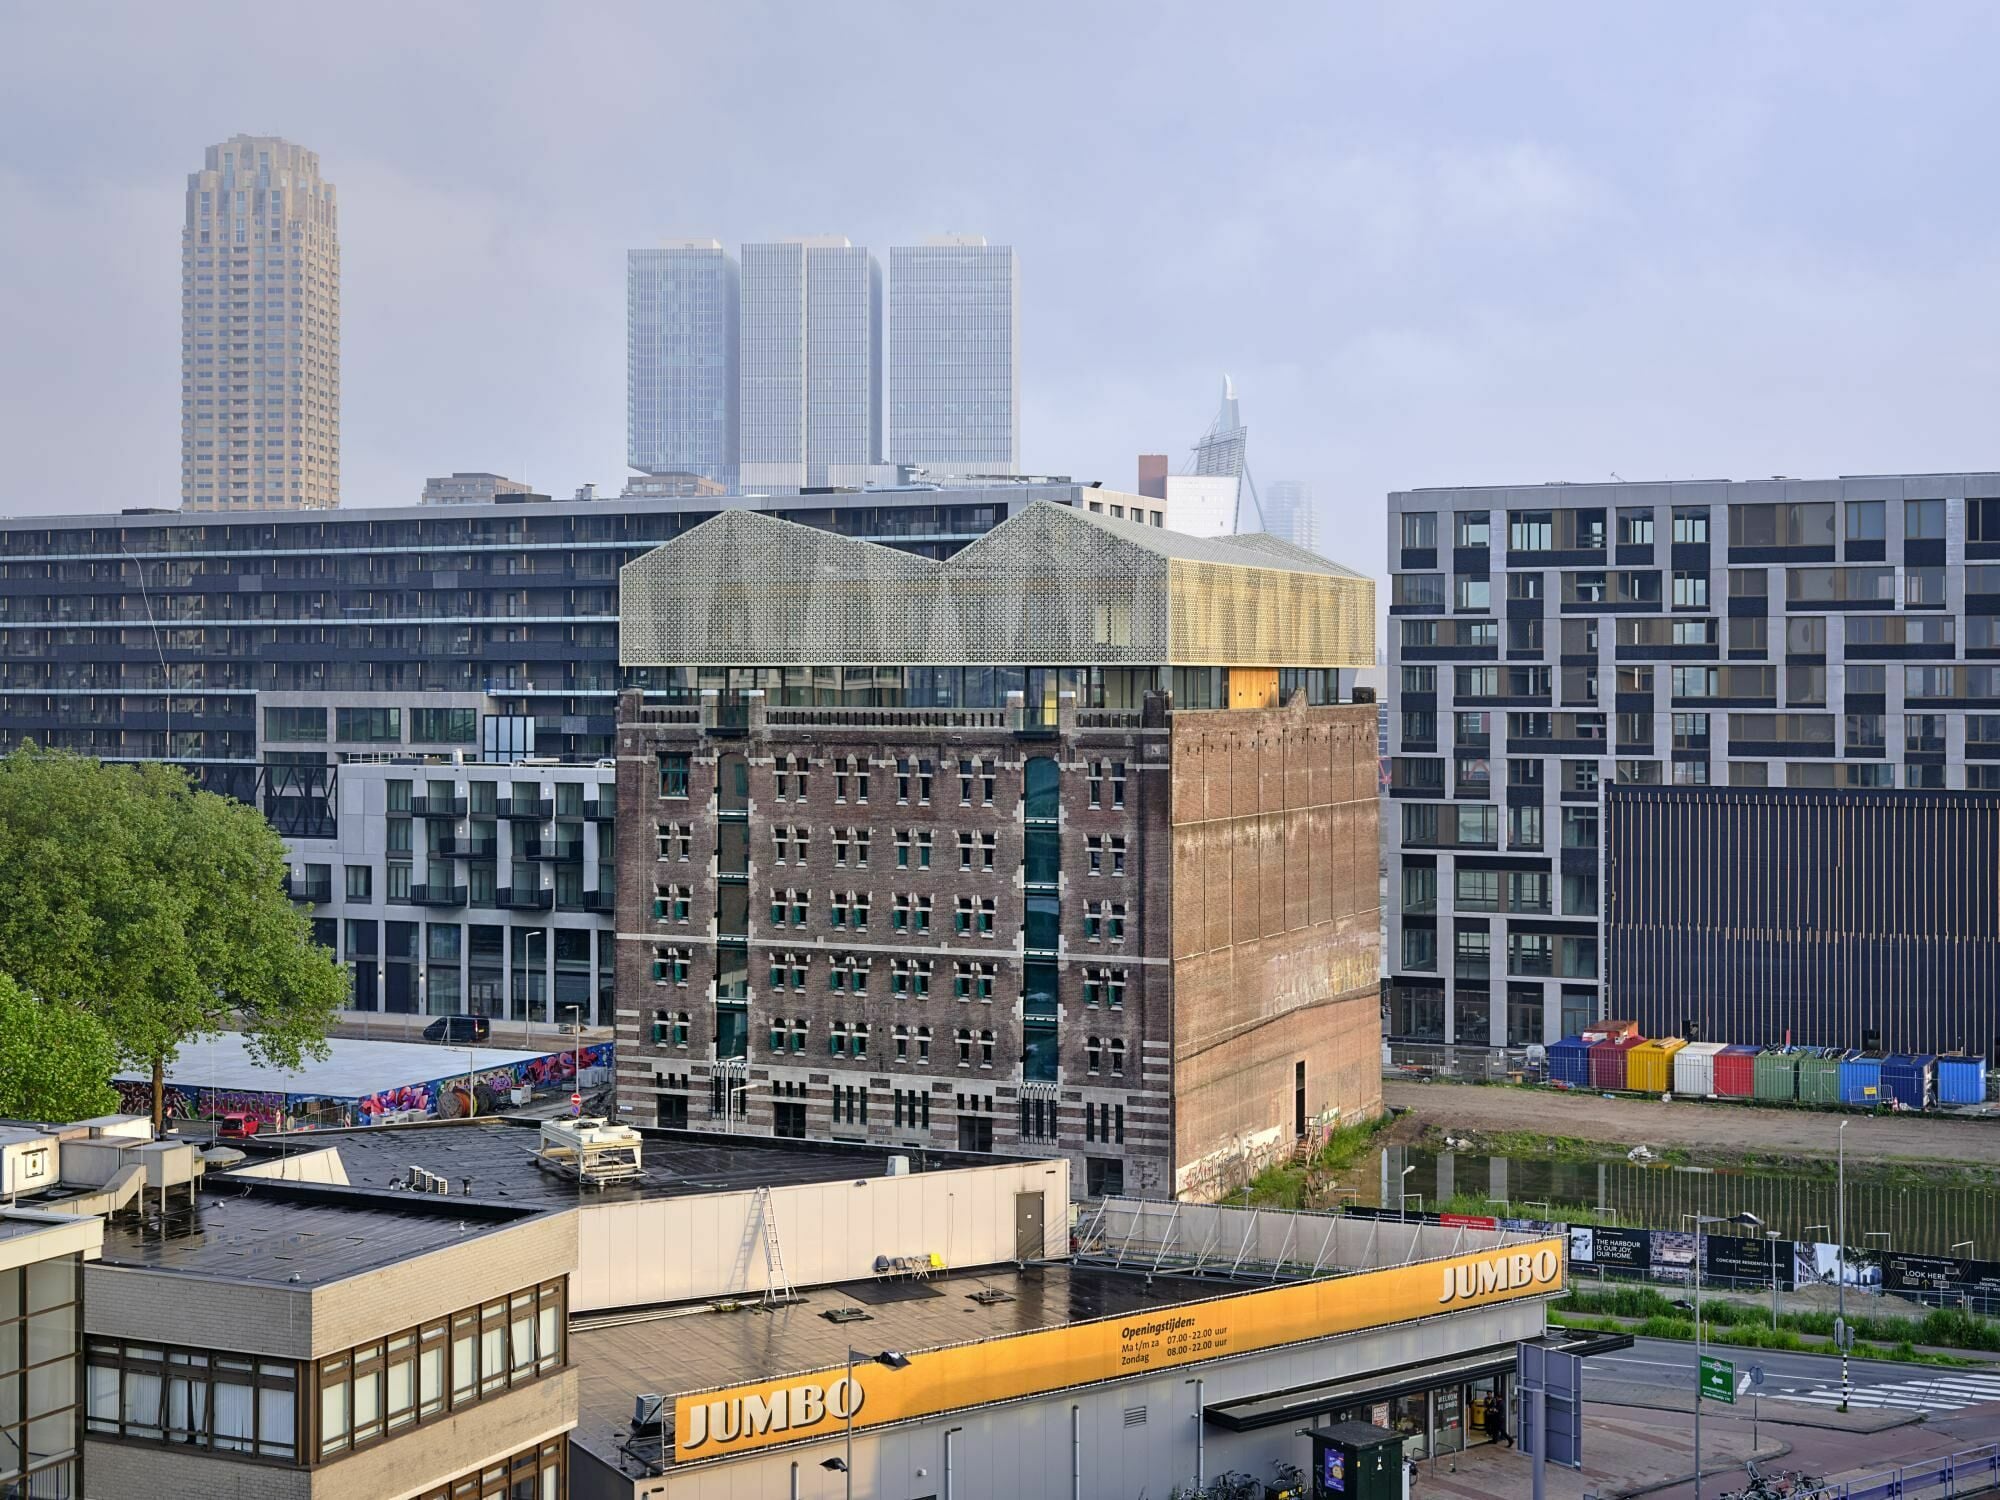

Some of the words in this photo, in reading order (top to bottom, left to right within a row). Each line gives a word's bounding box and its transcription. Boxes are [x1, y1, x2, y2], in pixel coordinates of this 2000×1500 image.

[1610, 1240, 1640, 1248] HARBOUR
[1440, 1249, 1558, 1303] JUMBO
[1905, 1270, 1926, 1278] LOOK
[1122, 1317, 1195, 1340] Openingstijden:
[1122, 1344, 1134, 1353] Ma
[1136, 1340, 1150, 1352] t/m
[1152, 1340, 1160, 1348] za
[1214, 1327, 1227, 1336] uur
[1122, 1354, 1150, 1366] Zondag
[1214, 1338, 1227, 1348] uur
[682, 1377, 865, 1449] JUMBO
